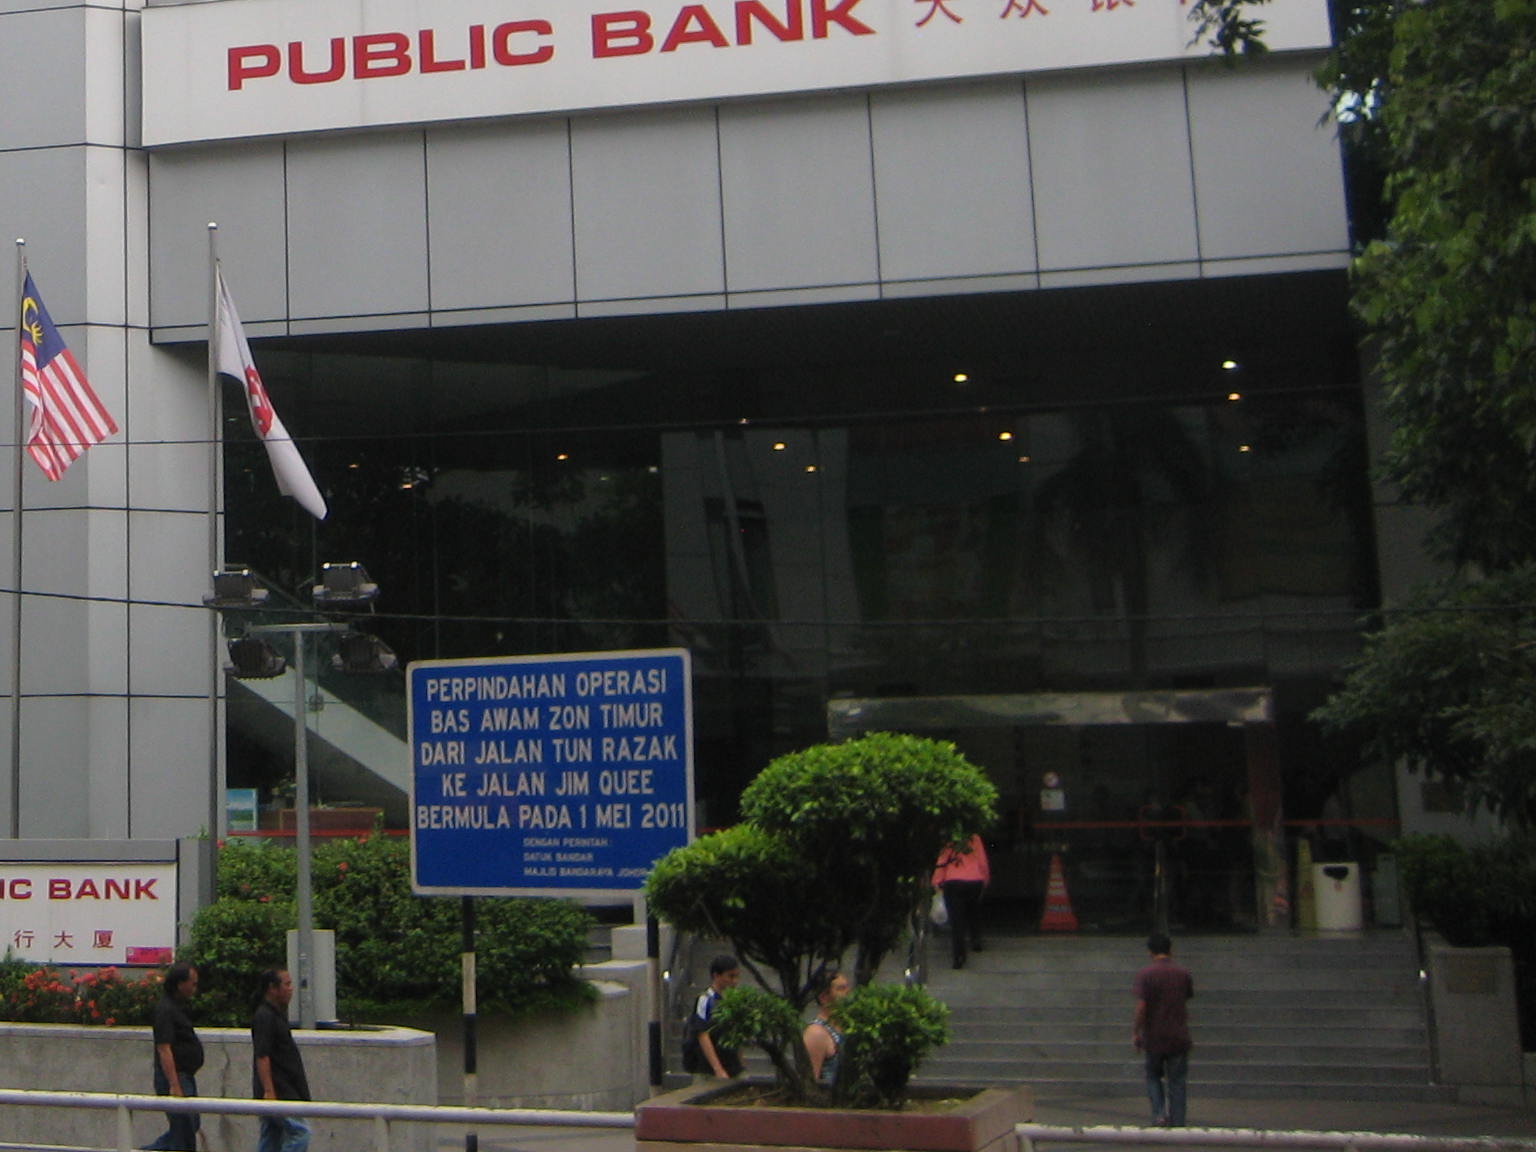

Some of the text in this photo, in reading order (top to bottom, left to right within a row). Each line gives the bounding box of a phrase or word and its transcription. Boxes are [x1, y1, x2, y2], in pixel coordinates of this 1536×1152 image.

[226, 17, 556, 91] PUBLIC
[426, 668, 666, 702] PERPINDAHAN OPERASI
[430, 702, 663, 734] BAS AWAM ZON TIMUR
[420, 735, 678, 766] DARI JALAN TUN RAZAK
[441, 769, 655, 797] KE JALAN JIM QUEE
[417, 802, 686, 829] BERMULA PADA 1 MEI 2011
[48, 878, 159, 900] BANK
